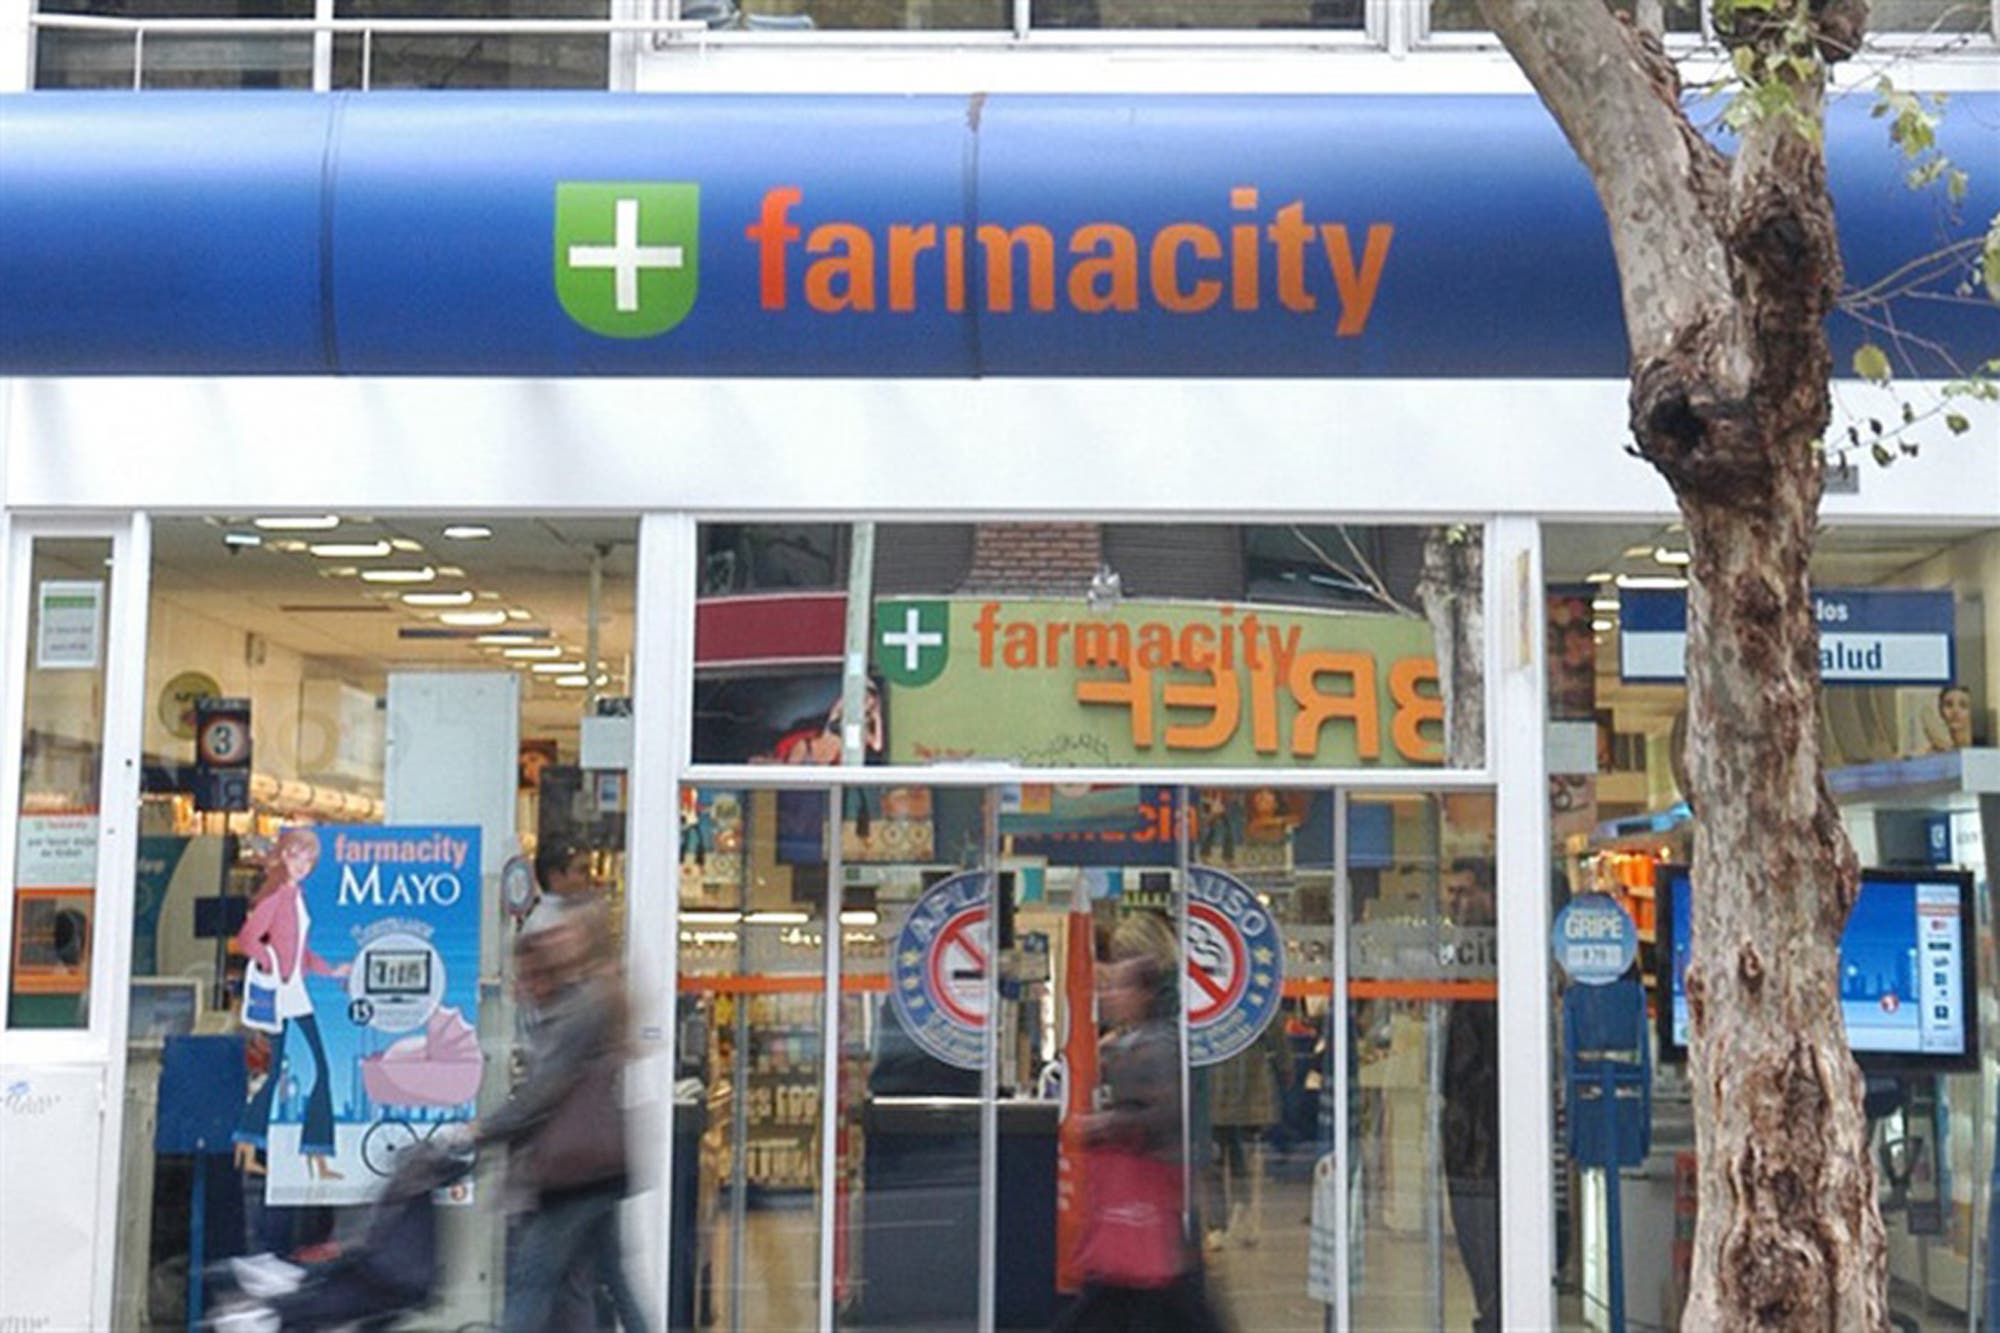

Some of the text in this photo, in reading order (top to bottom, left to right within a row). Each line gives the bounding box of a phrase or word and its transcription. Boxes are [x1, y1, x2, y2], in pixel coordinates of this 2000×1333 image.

[745, 186, 1394, 337] farmacity
[973, 600, 1302, 688] farmacity
[1819, 641, 1882, 671] alud
[213, 725, 233, 756] 3
[335, 833, 468, 871] farmacity
[337, 863, 461, 907] MAYO
